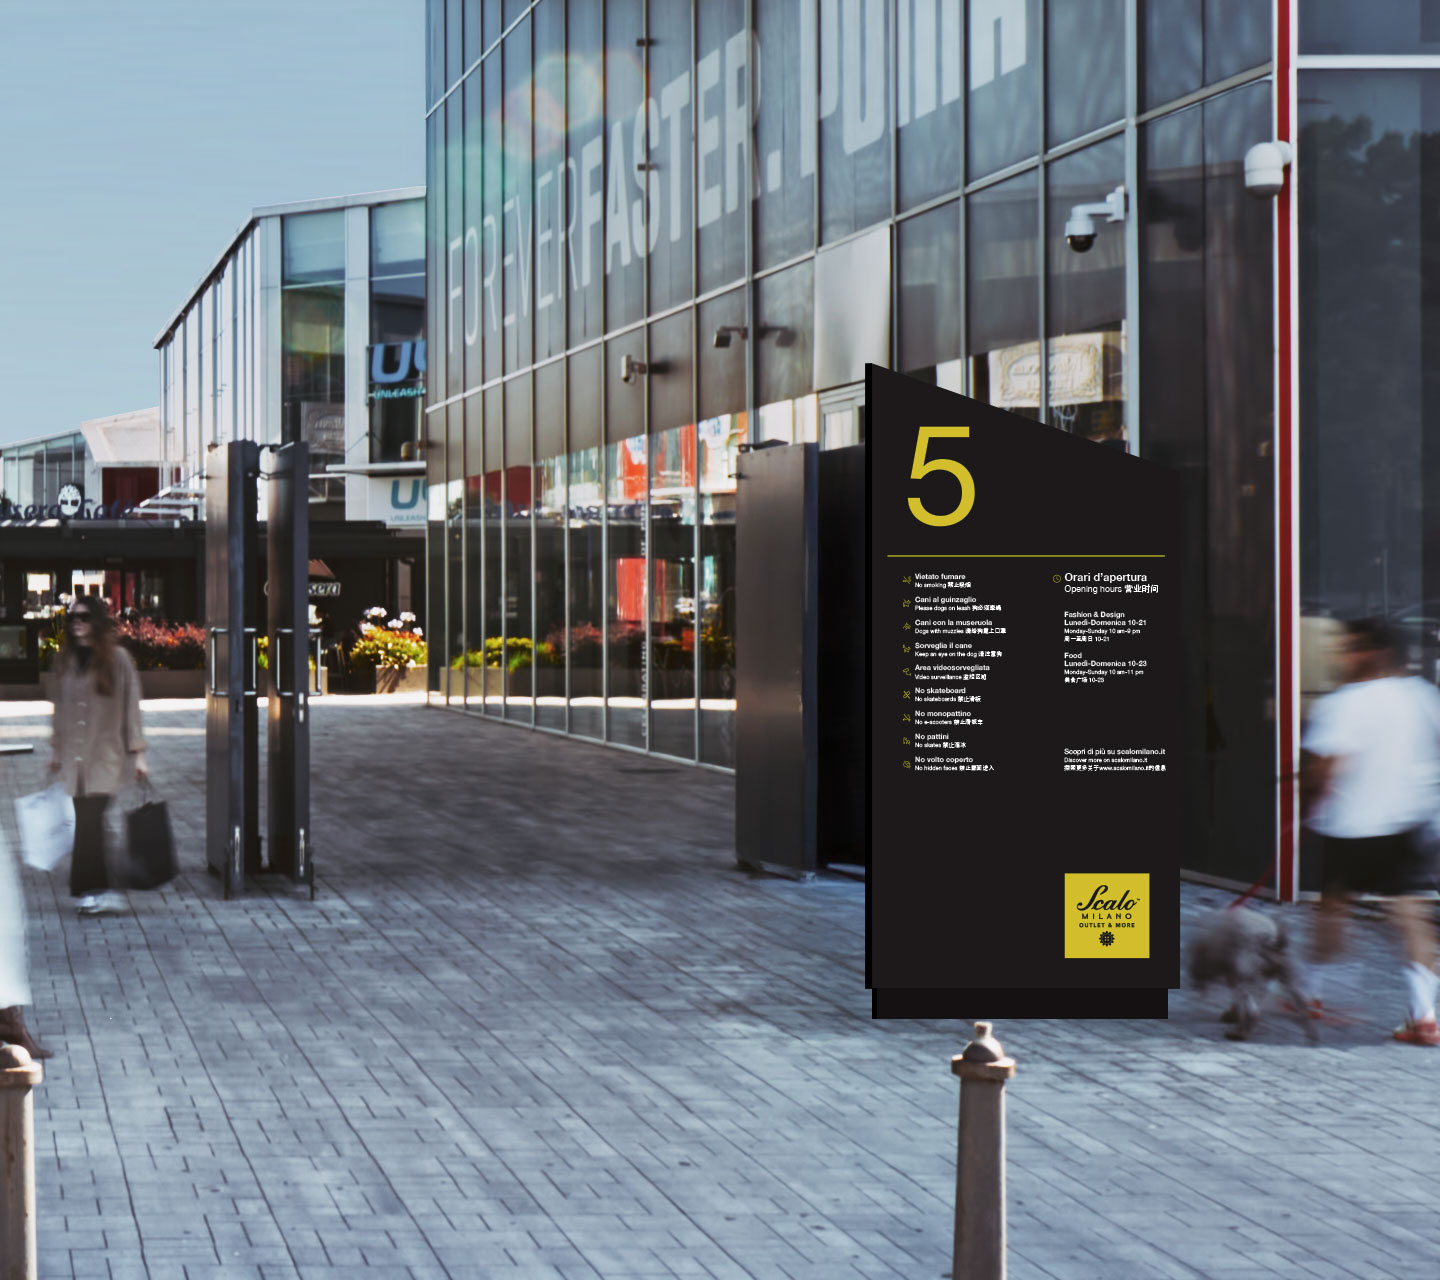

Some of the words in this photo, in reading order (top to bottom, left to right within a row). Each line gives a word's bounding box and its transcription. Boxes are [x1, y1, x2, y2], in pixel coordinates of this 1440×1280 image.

[907, 425, 976, 527] 5
[1064, 573, 1091, 582] Orari
[1064, 585, 1098, 594] Opening
[1100, 585, 1123, 593] hours
[941, 596, 977, 604] guinzaglio
[915, 642, 948, 650] Sorveglia
[933, 664, 991, 672] videosorvegliata
[927, 710, 972, 718] monopattino
[927, 733, 950, 741] pattini
[1064, 748, 1086, 756] Scopri
[946, 756, 974, 764] coperto
[1077, 885, 1138, 911] Scalo
